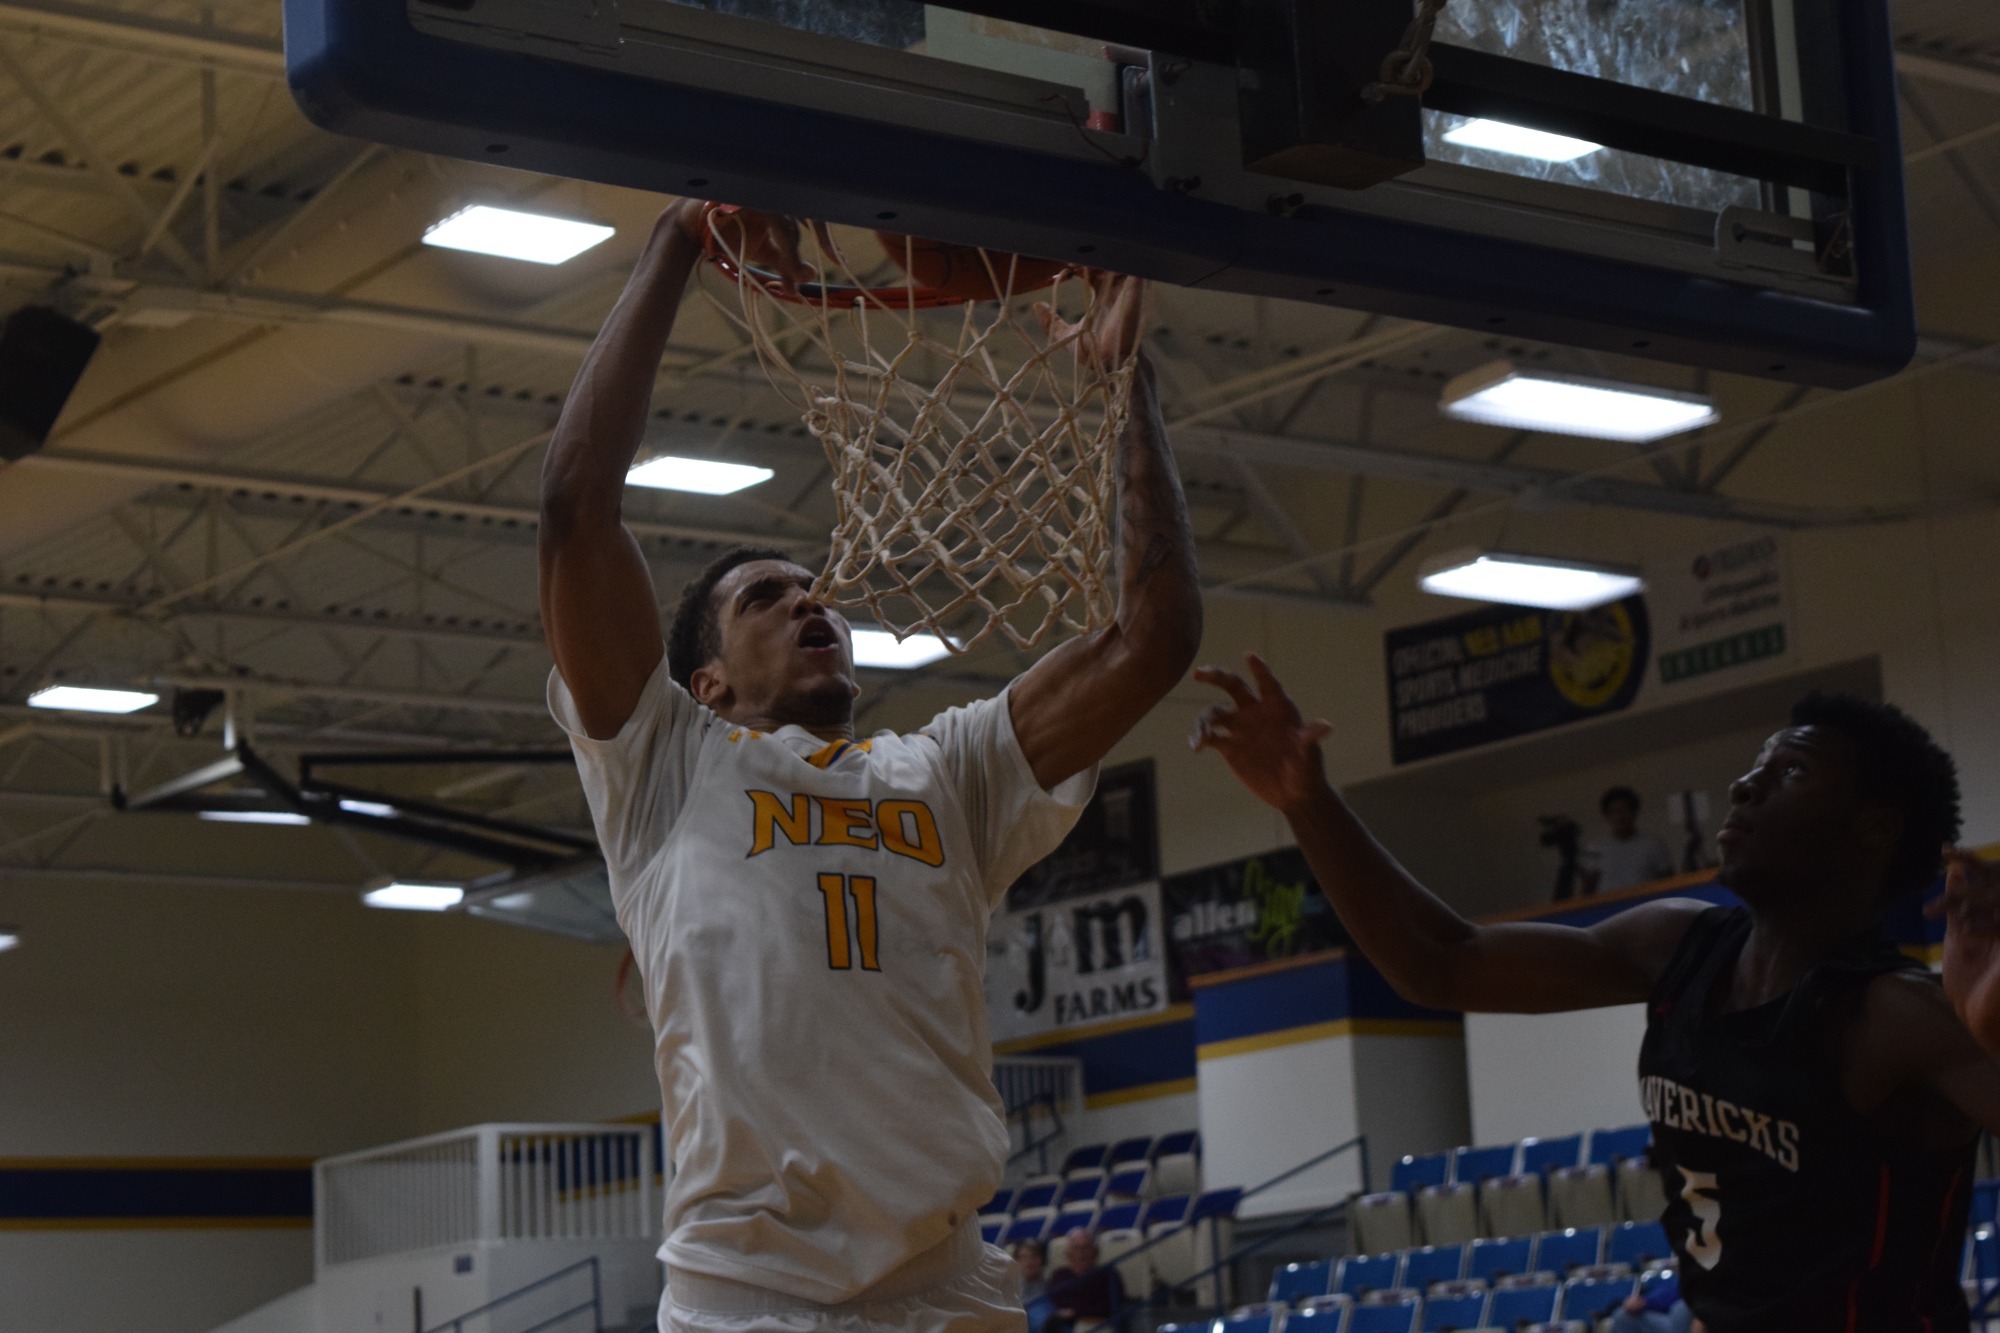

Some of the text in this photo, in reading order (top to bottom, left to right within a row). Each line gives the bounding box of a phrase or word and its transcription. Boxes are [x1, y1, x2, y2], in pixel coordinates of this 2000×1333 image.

[745, 790, 945, 868] NEO
[817, 872, 881, 972] 11
[1055, 977, 1159, 1025] FARMS
[1640, 1074, 1800, 1173] AVERICKS
[1675, 1163, 1722, 1271] 5
